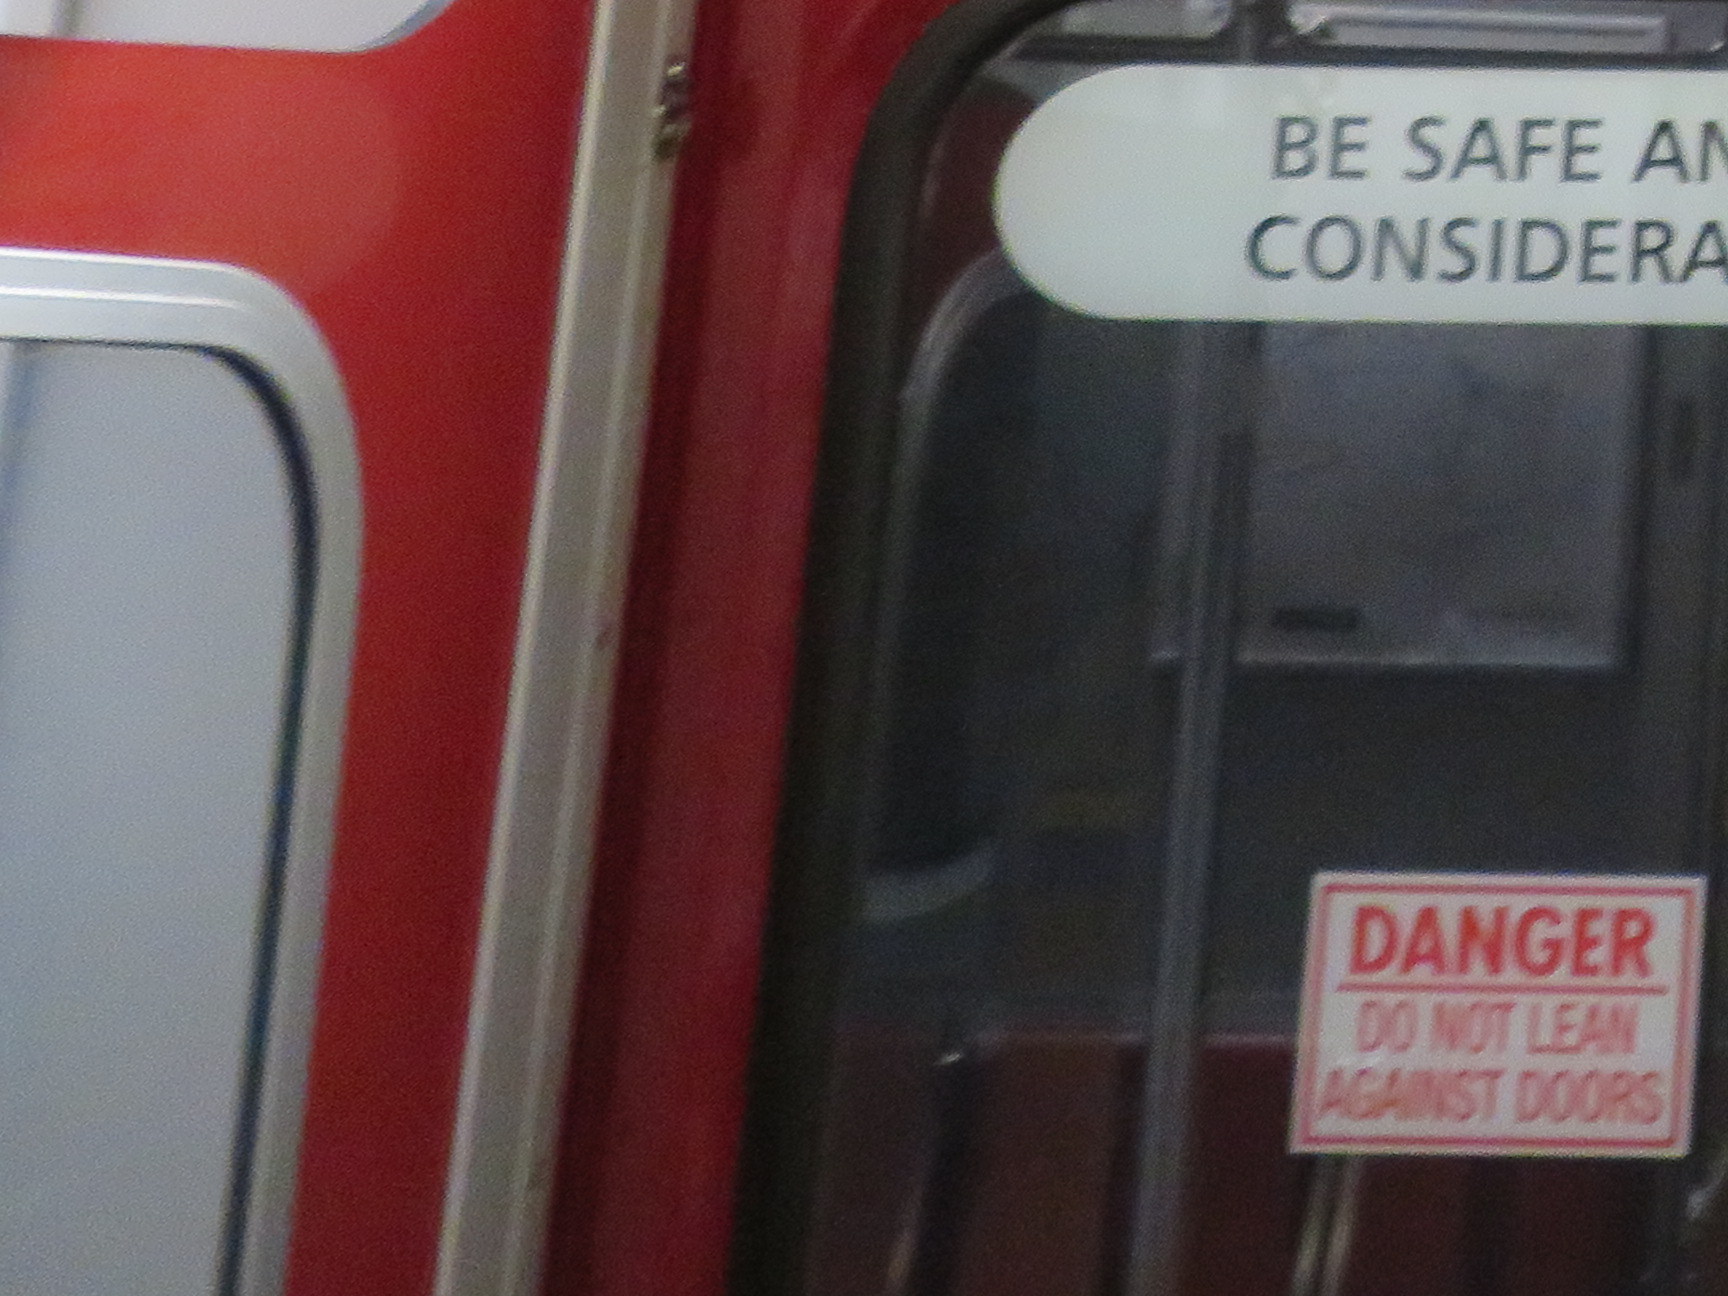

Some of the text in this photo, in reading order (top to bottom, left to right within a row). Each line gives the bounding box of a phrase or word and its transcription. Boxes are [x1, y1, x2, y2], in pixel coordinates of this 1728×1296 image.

[1270, 116, 1368, 181] BE
[1402, 117, 1604, 184] SAFE
[1349, 905, 1655, 977] DANGER
[1356, 1000, 1639, 1055] DO NOT LEAN
[1320, 1068, 1662, 1124] AGAINST DOORS
